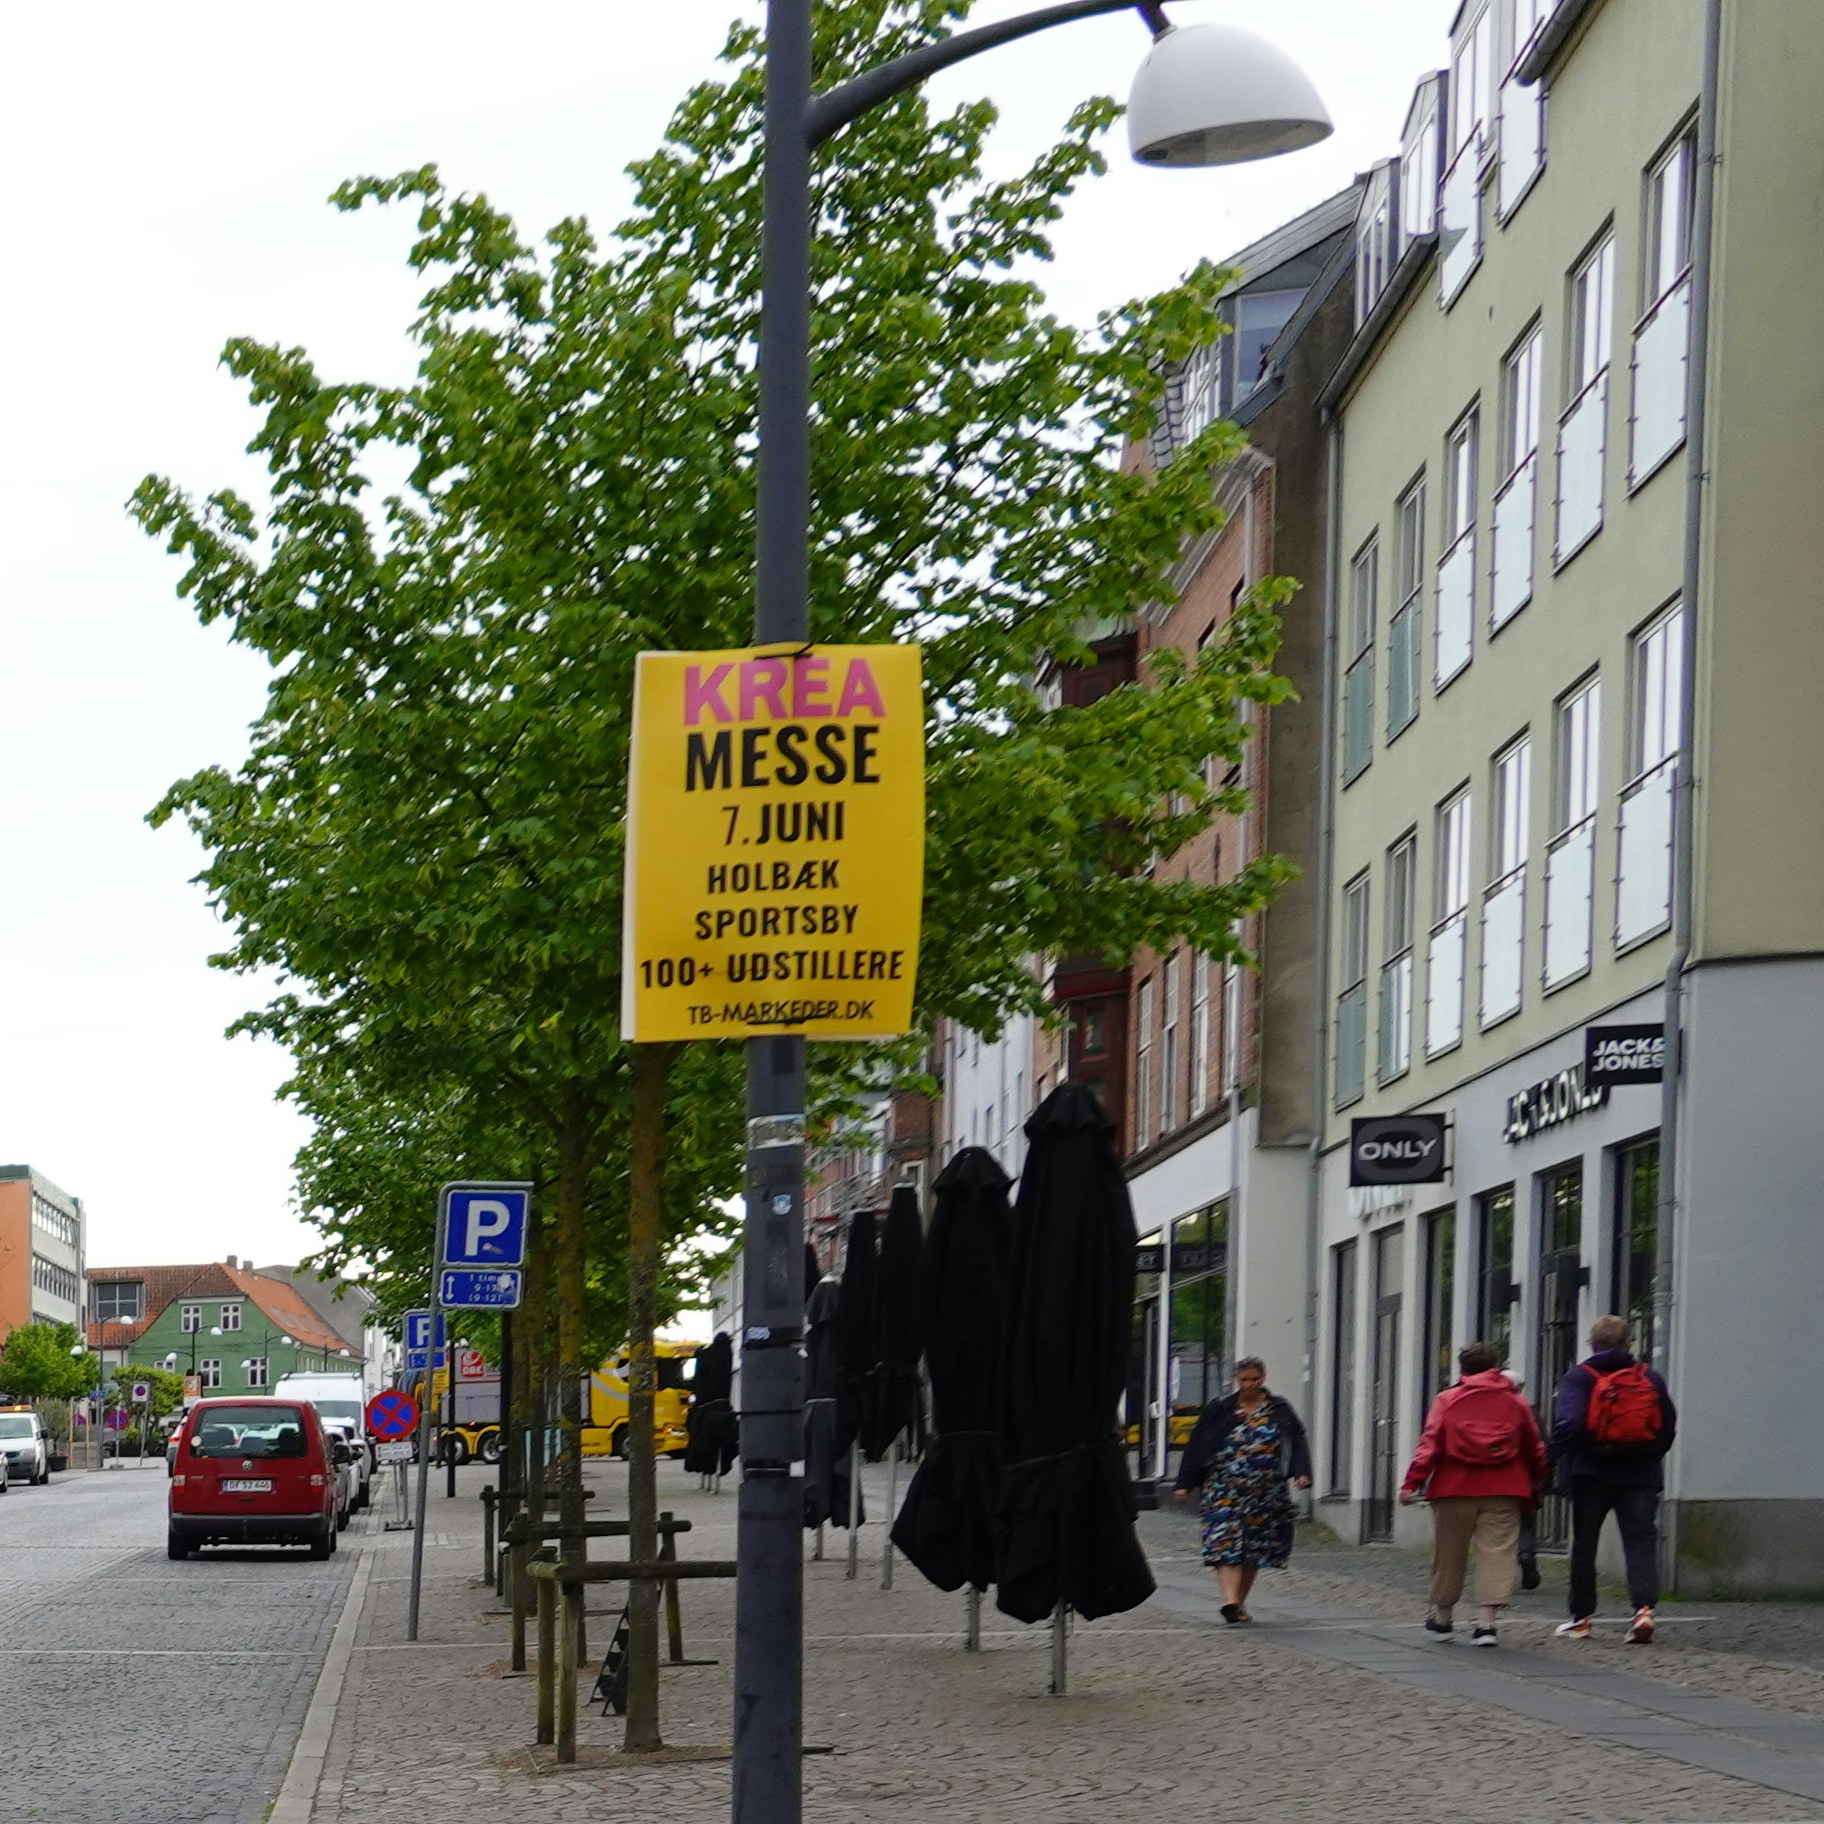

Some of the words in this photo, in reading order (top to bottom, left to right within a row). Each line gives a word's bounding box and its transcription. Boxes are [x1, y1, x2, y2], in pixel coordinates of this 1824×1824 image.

[684, 657, 887, 725] KREA
[685, 724, 880, 793] MESSE
[707, 859, 839, 895] HOLBÆK
[695, 904, 859, 940] SPORTSBY
[641, 956, 715, 988] 100+
[727, 949, 903, 984] UDSTILLERE
[688, 1000, 875, 1026] TB-MARKEDER.DK
[1358, 1137, 1438, 1161] ONLY
